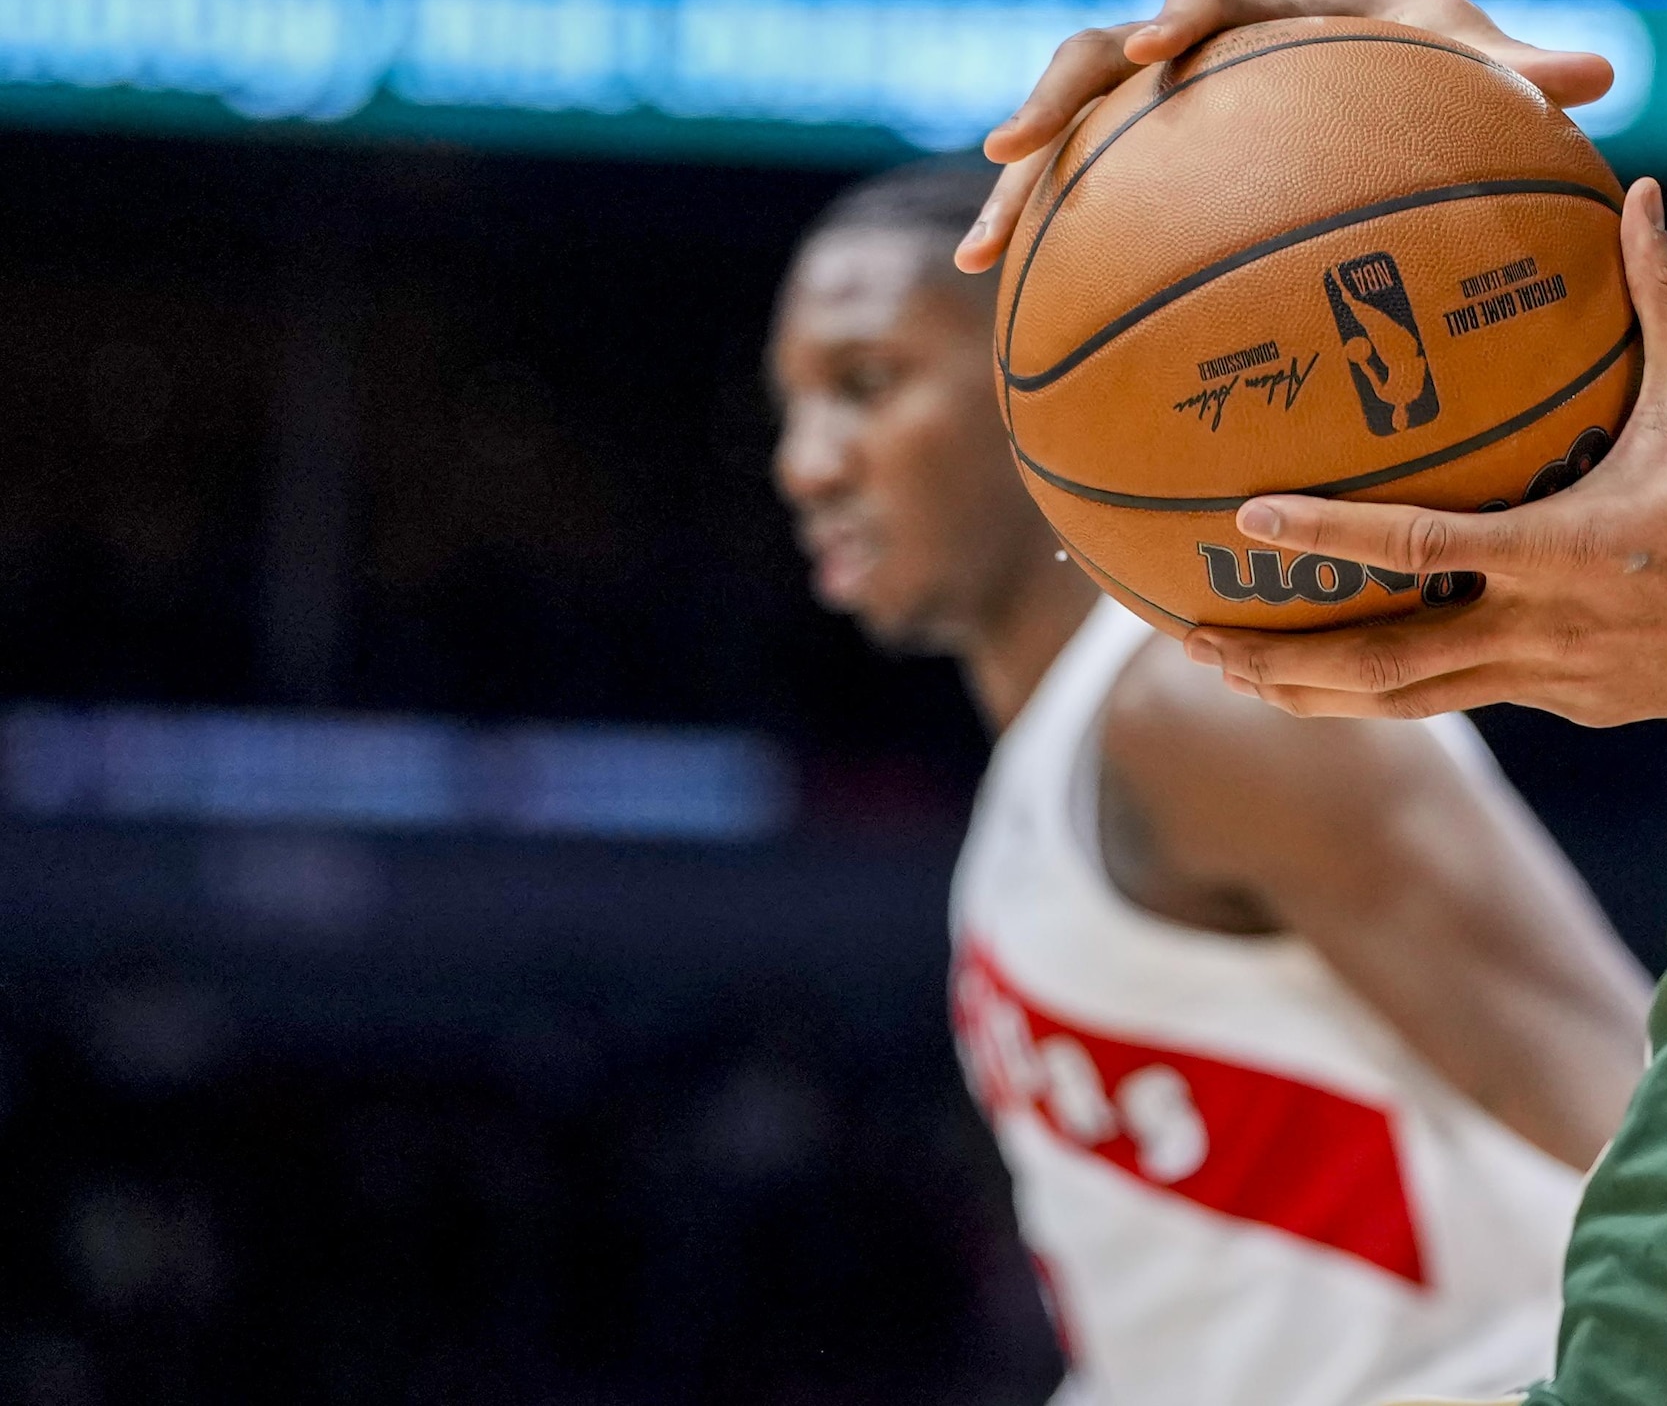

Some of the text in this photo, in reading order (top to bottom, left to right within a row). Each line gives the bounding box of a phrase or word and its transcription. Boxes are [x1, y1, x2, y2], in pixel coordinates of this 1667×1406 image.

[1350, 260, 1394, 296] NBA
[1459, 256, 1538, 299] GENUINE LEATHER
[1442, 274, 1568, 338] OFFICIAL GAME BALL
[1197, 339, 1280, 382] COMMISSIONER
